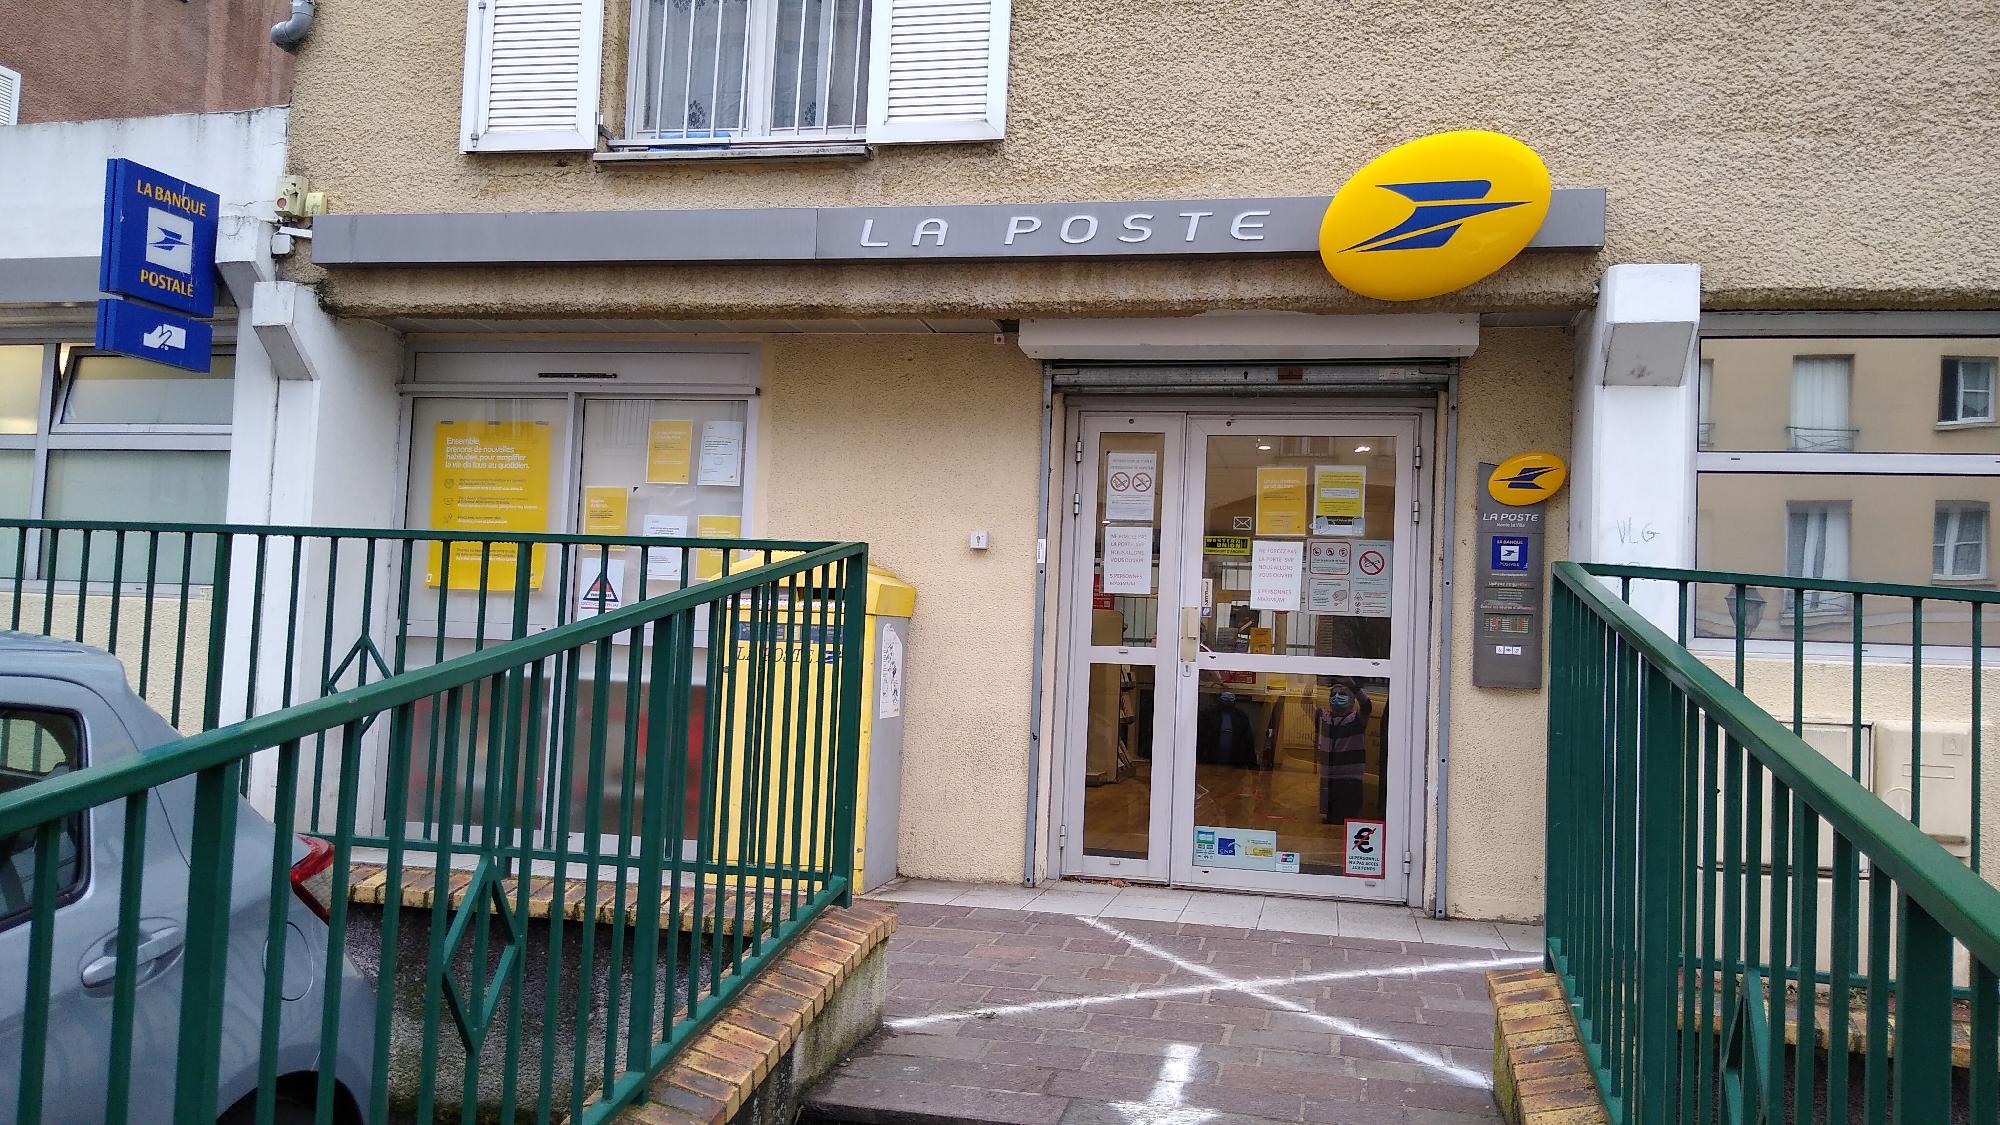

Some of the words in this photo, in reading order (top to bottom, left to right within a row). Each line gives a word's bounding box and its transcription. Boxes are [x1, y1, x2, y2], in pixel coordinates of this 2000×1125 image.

[137, 178, 153, 198] LA
[155, 187, 207, 218] BANQUE
[859, 217, 949, 248] LA
[1003, 209, 1272, 246] POSTE
[140, 269, 195, 298] POSTALE
[1482, 513, 1498, 521] LA
[1501, 513, 1539, 522] POSTE
